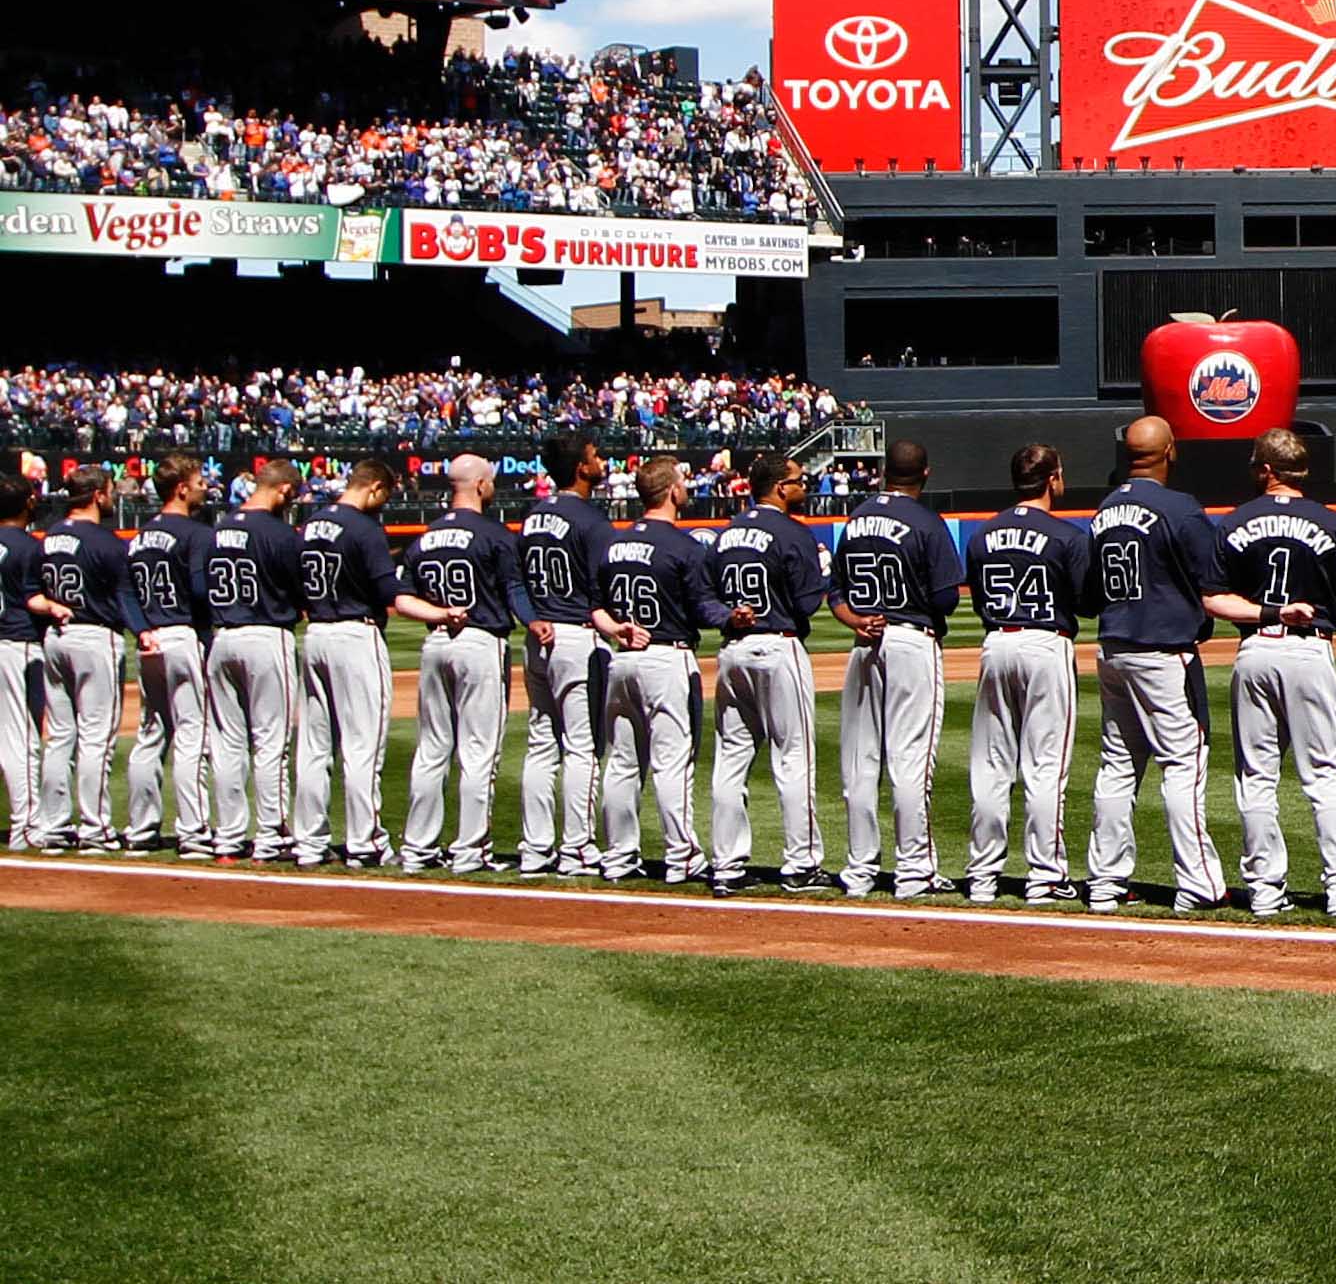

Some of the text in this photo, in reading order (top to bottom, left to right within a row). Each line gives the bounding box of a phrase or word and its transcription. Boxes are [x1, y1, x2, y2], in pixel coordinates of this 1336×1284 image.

[784, 79, 950, 109] TOYOTA
[0, 201, 321, 250] den Veggie Straws
[580, 228, 674, 241] DISCOUNT
[704, 234, 737, 247] CATCH
[554, 240, 698, 269] FURNITURE
[705, 256, 803, 273] MYBOBS.COM
[846, 517, 912, 545] MARTINEZ
[986, 528, 1047, 555] MEDLEN
[1227, 516, 1336, 555] PASTORNICKY
[209, 558, 258, 607] 36
[301, 551, 343, 601] 37
[418, 560, 477, 610] 39
[525, 546, 572, 598] 40
[721, 562, 771, 618] 49
[847, 553, 908, 610] 50
[982, 564, 1054, 621] 54
[1101, 541, 1142, 602] 61
[1264, 548, 1290, 607] 1
[609, 573, 661, 628] 46
